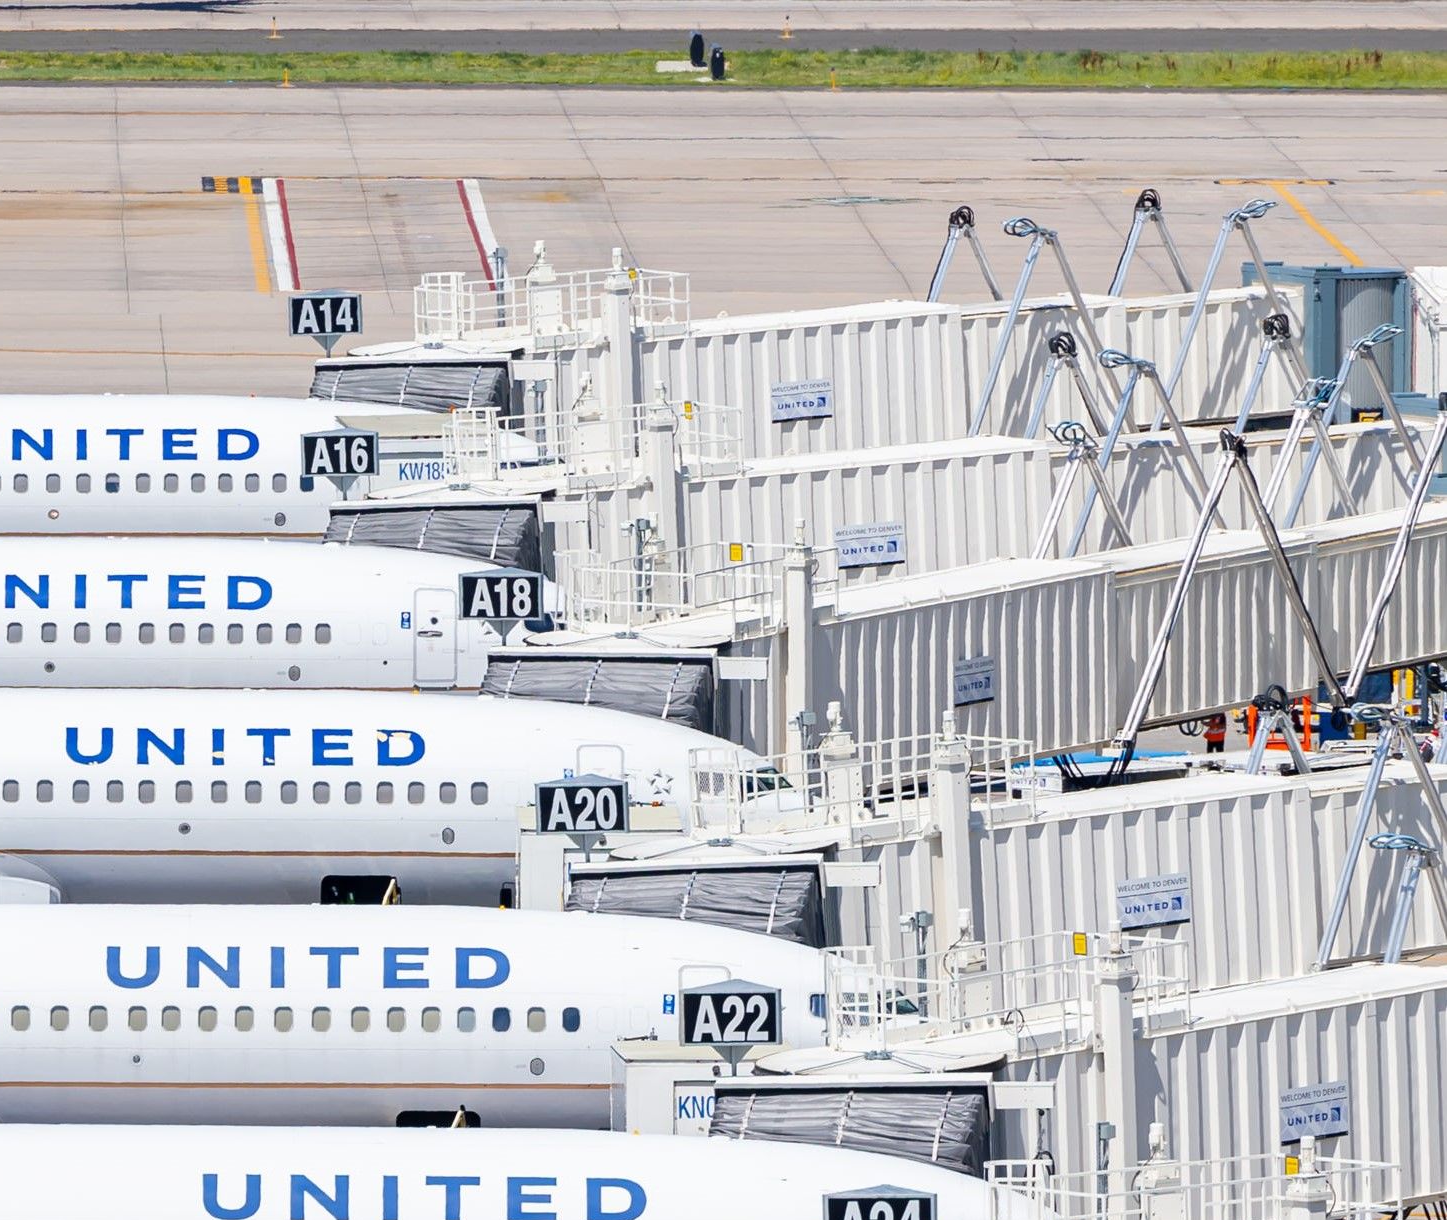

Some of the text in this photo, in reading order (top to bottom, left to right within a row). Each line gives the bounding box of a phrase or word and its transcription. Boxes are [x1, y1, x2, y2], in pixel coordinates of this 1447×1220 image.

[298, 299, 353, 333] A14
[777, 401, 815, 410] UNITED
[311, 437, 369, 474] A16
[842, 545, 884, 555] UNITED
[470, 578, 532, 616] A18
[958, 681, 984, 692] UNITED
[66, 727, 425, 767] UNITED
[548, 788, 618, 830] A20
[1117, 883, 1150, 893] WELCOME
[1163, 877, 1188, 887] DENVER
[1124, 902, 1169, 914] UNITED
[106, 946, 511, 989] UNITED
[692, 995, 769, 1042] A22
[1280, 1086, 1346, 1103] WELCOME TO DENVER
[1287, 1112, 1329, 1127] UNITED
